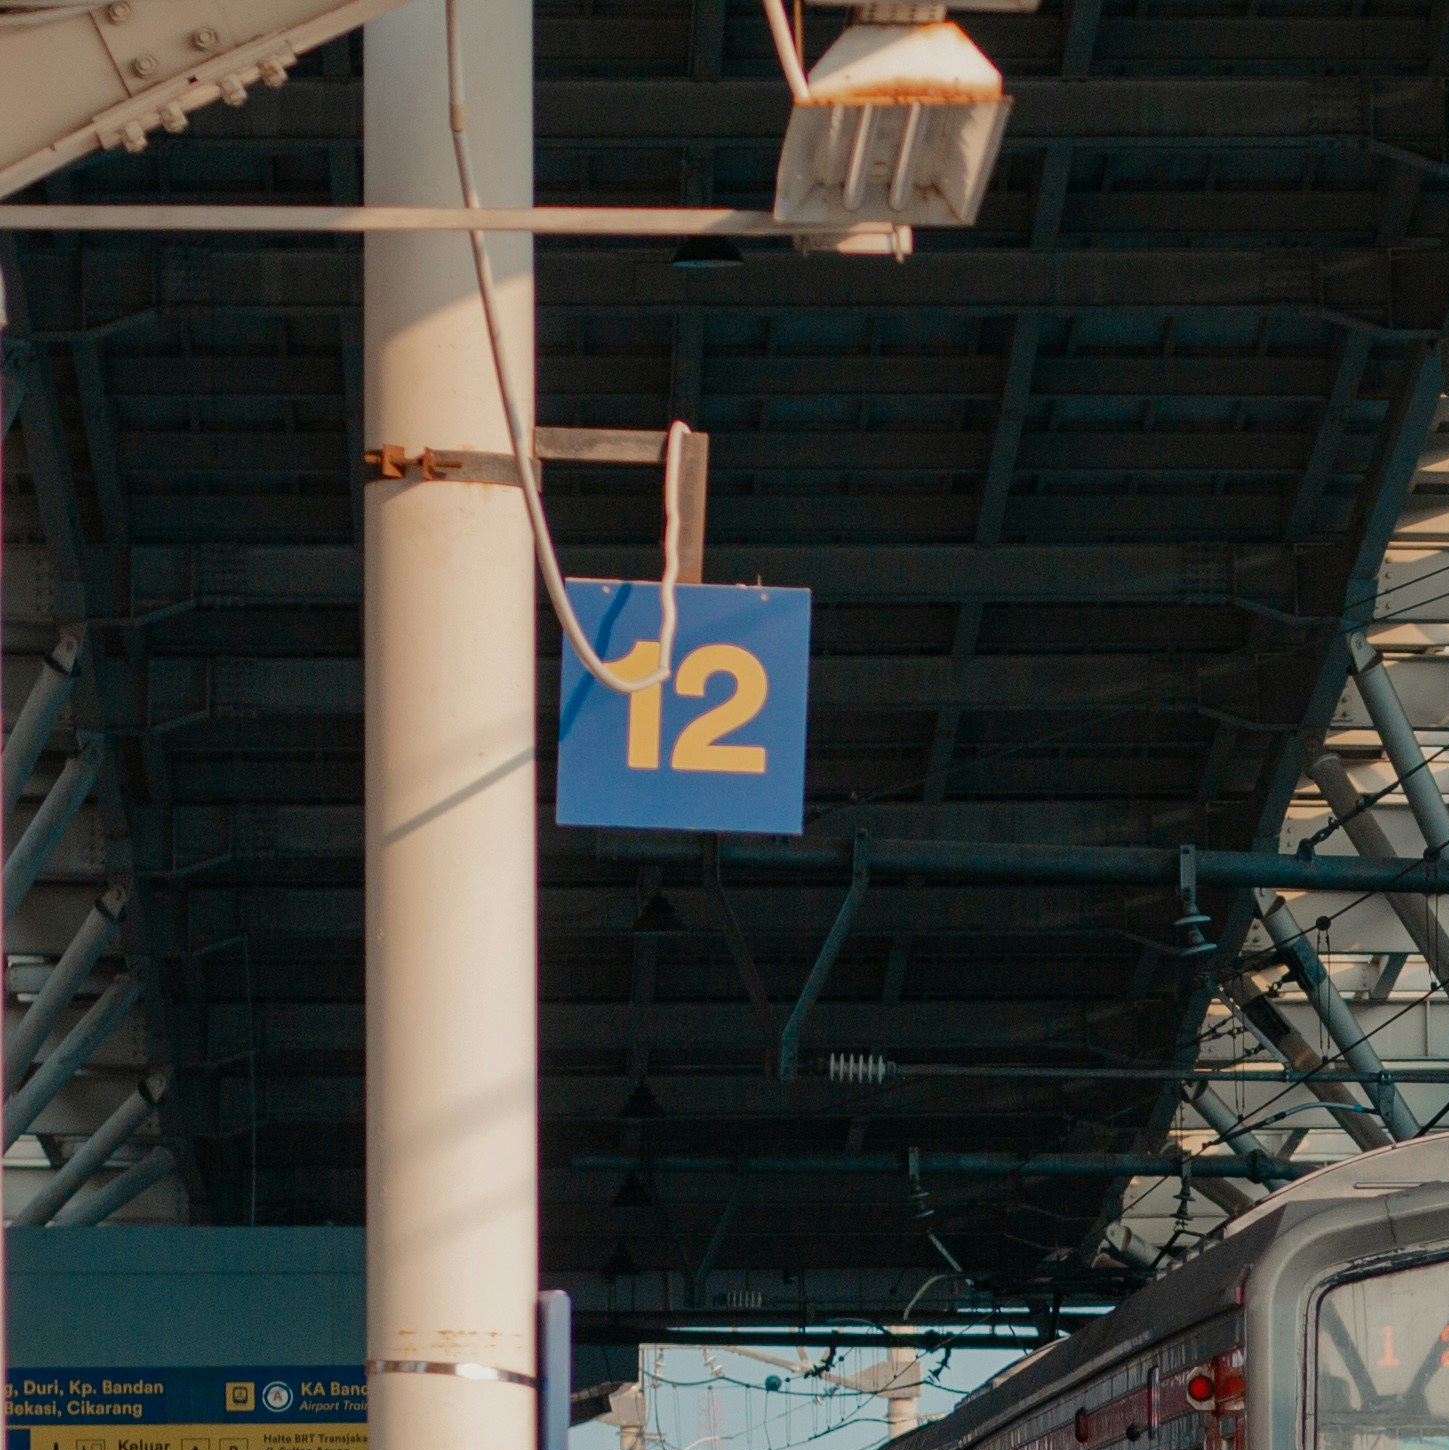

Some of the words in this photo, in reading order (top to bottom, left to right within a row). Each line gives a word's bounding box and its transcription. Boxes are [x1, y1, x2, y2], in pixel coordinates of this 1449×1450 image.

[602, 640, 768, 774] 12
[23, 1379, 64, 1397] Duri,
[69, 1380, 97, 1397] Kp.
[102, 1379, 164, 1395] Bandan
[301, 1382, 325, 1396] KA
[66, 1400, 143, 1418] Cikarang
[299, 1400, 340, 1413] Airport
[263, 1434, 292, 1443] Halte
[295, 1434, 315, 1443] BRT
